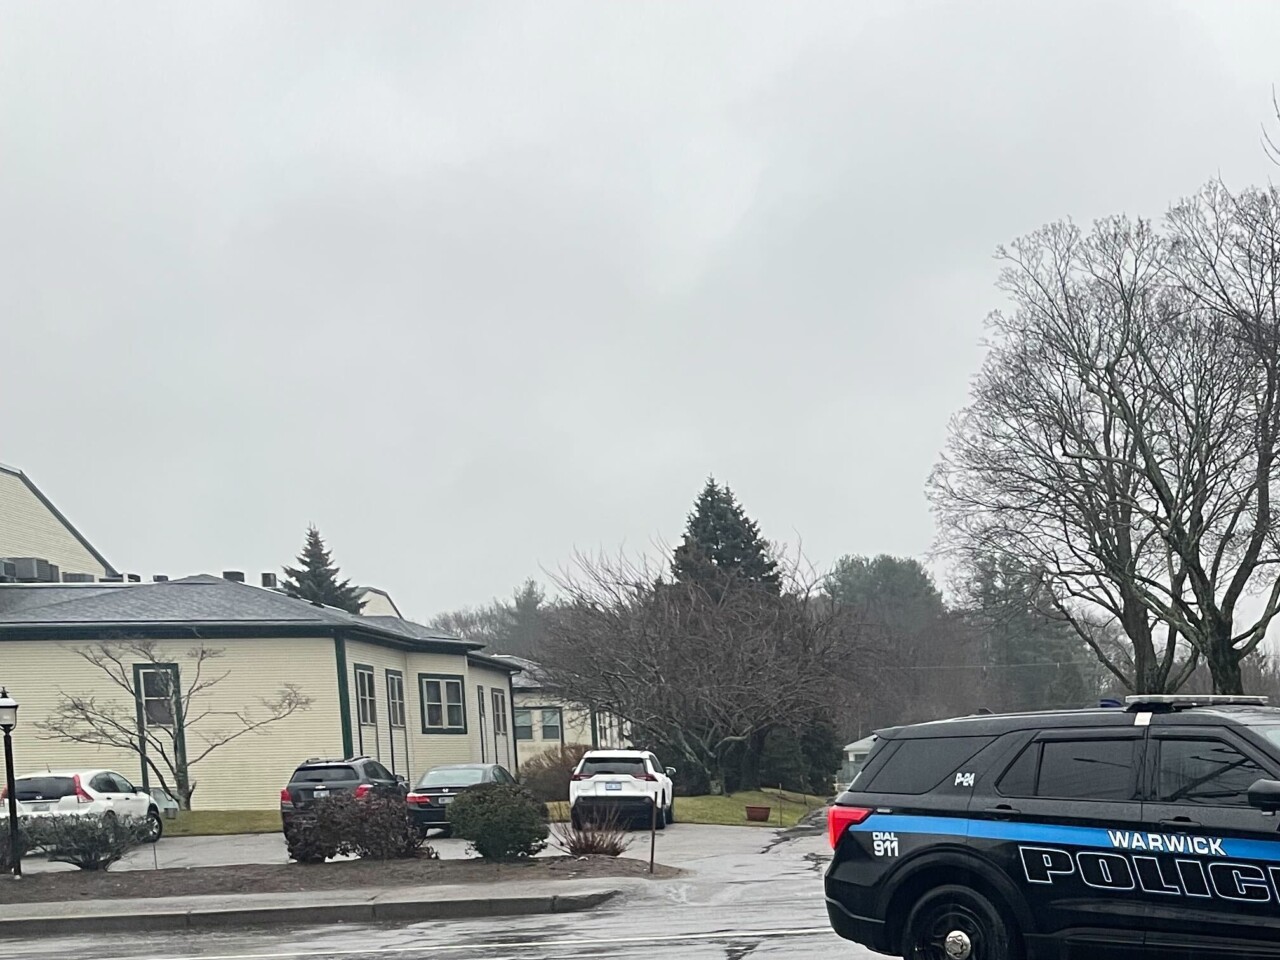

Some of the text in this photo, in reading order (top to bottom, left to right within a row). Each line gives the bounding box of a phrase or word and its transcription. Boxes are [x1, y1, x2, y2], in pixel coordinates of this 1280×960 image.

[954, 772, 975, 787] P-24
[872, 832, 898, 841] DIAL
[1107, 830, 1227, 857] WARWICK
[873, 840, 899, 857] 911
